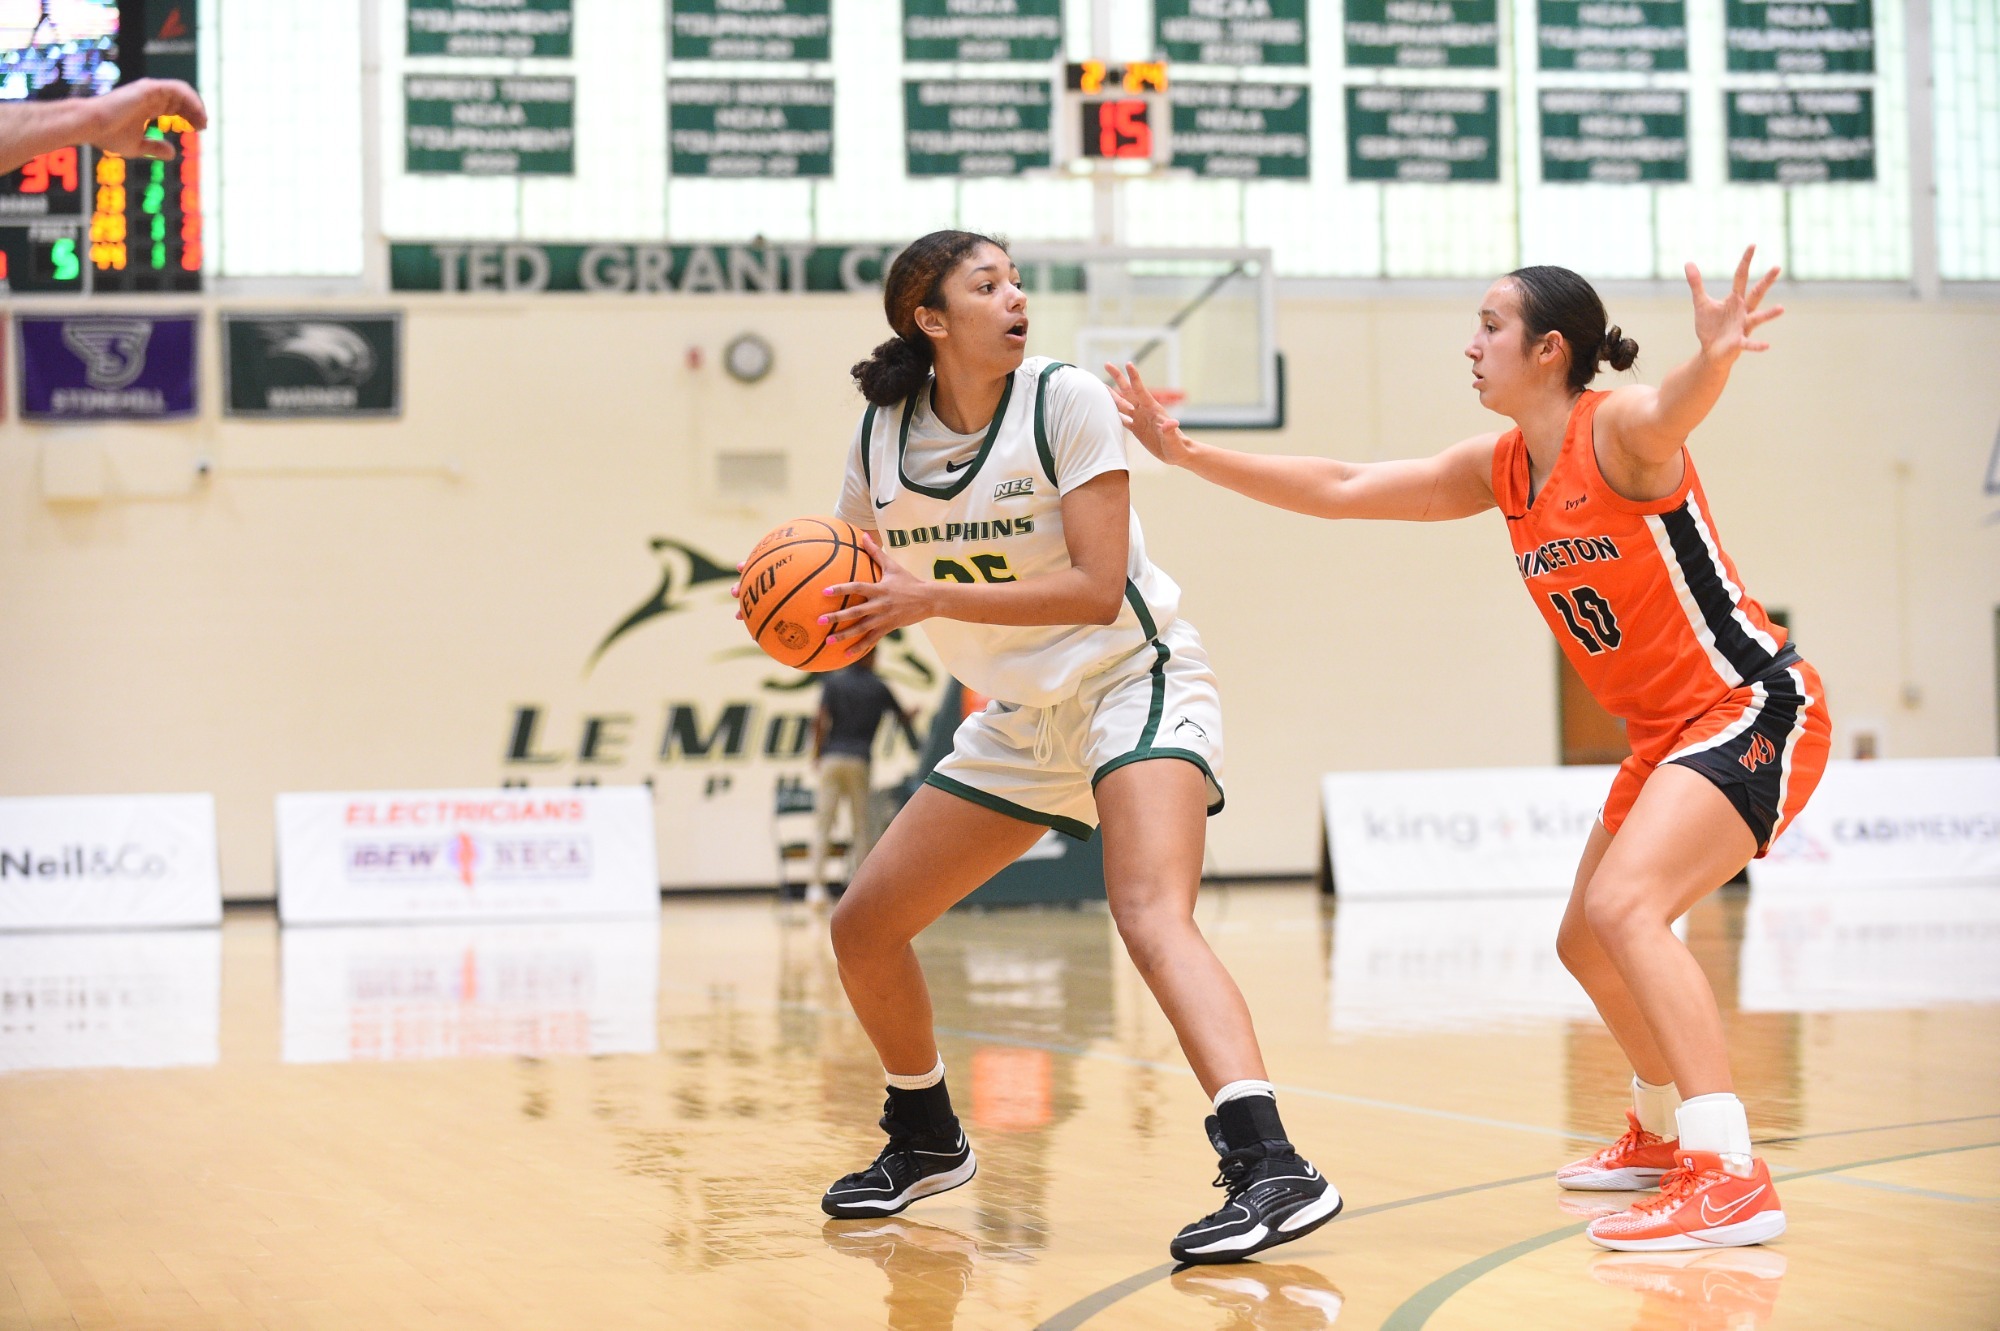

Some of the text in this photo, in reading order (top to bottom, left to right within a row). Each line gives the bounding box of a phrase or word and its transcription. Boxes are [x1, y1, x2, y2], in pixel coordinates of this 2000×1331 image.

[1099, 100, 1153, 158] 15
[432, 246, 551, 293] TED
[578, 245, 816, 293] GRANT
[994, 477, 1035, 499] NEC
[886, 514, 1036, 549] DOLPHINS
[1547, 584, 1623, 658] 10
